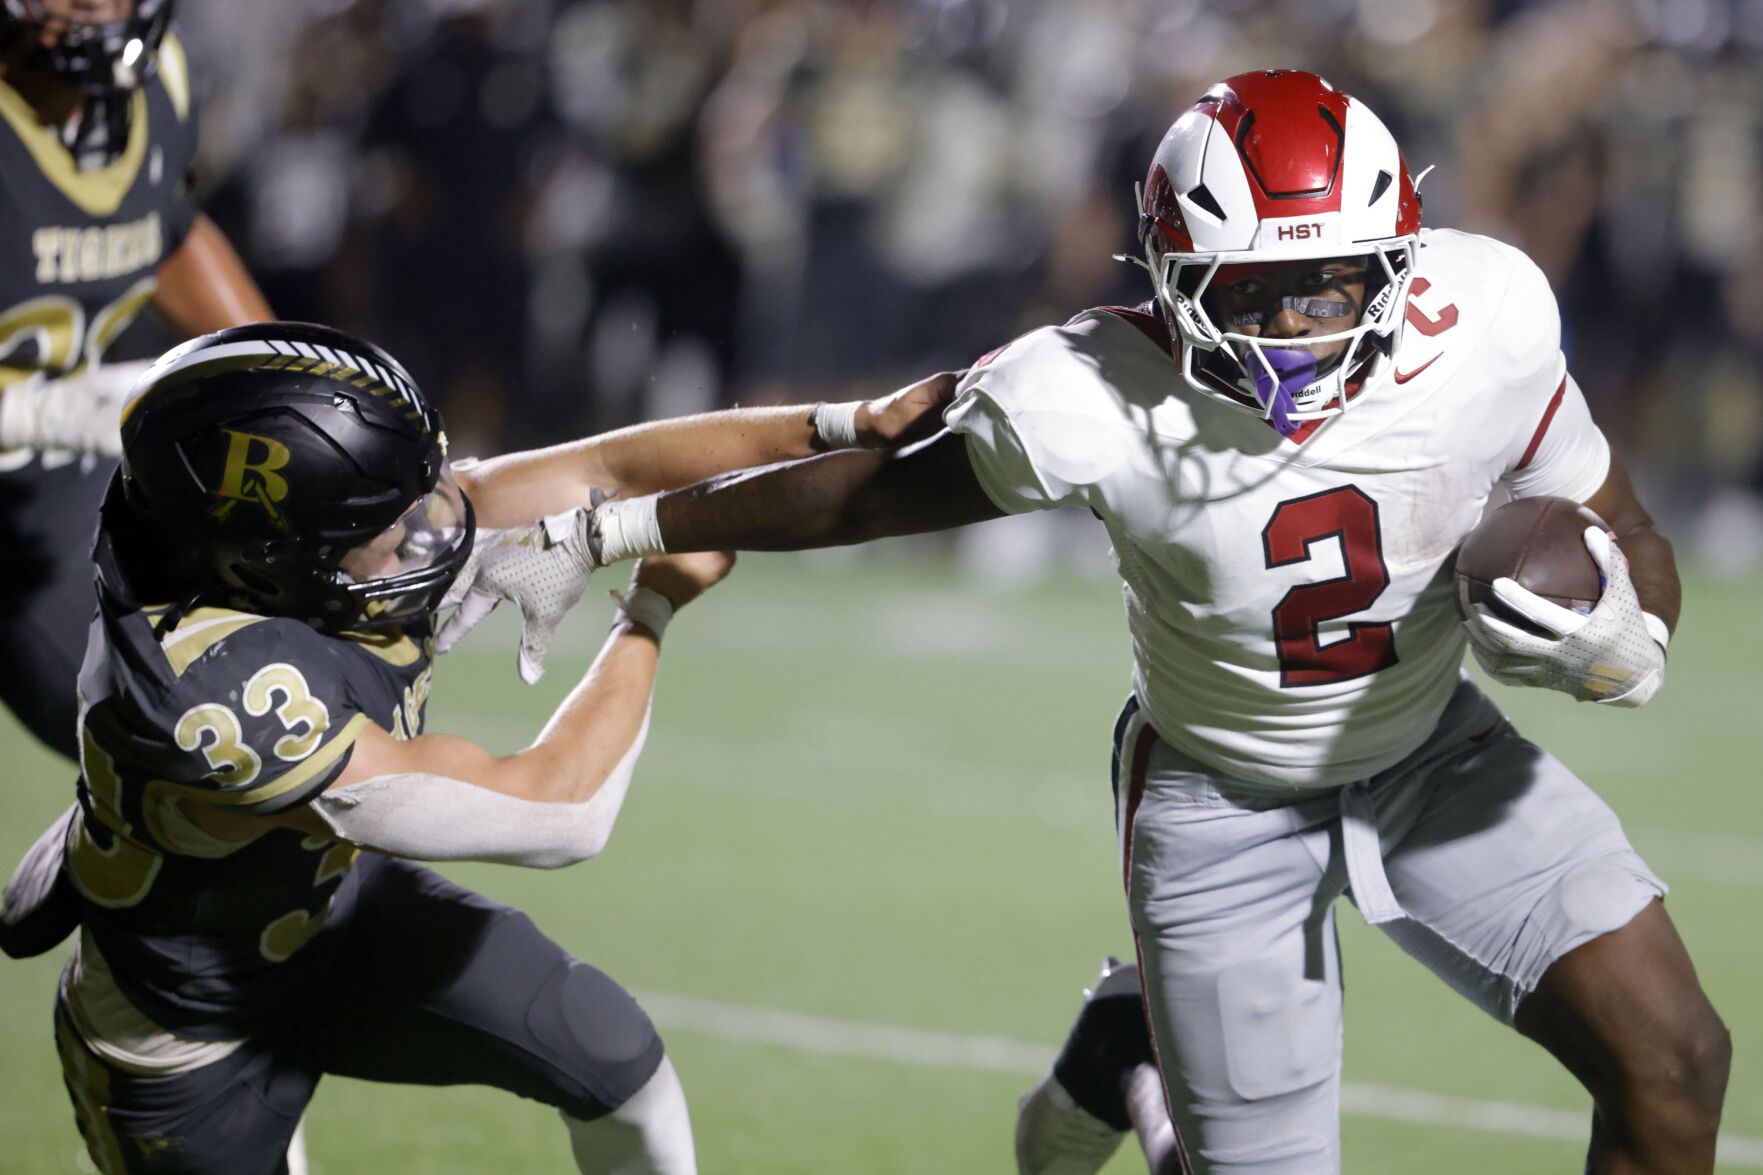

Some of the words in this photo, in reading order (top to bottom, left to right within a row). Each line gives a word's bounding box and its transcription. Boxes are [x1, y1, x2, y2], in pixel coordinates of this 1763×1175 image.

[32, 210, 163, 284] TIGERS
[1277, 222, 1325, 241] HST
[1406, 276, 1460, 337] C
[1290, 385, 1321, 399] iddell
[1261, 483, 1399, 689] 2
[174, 662, 330, 788] 33
